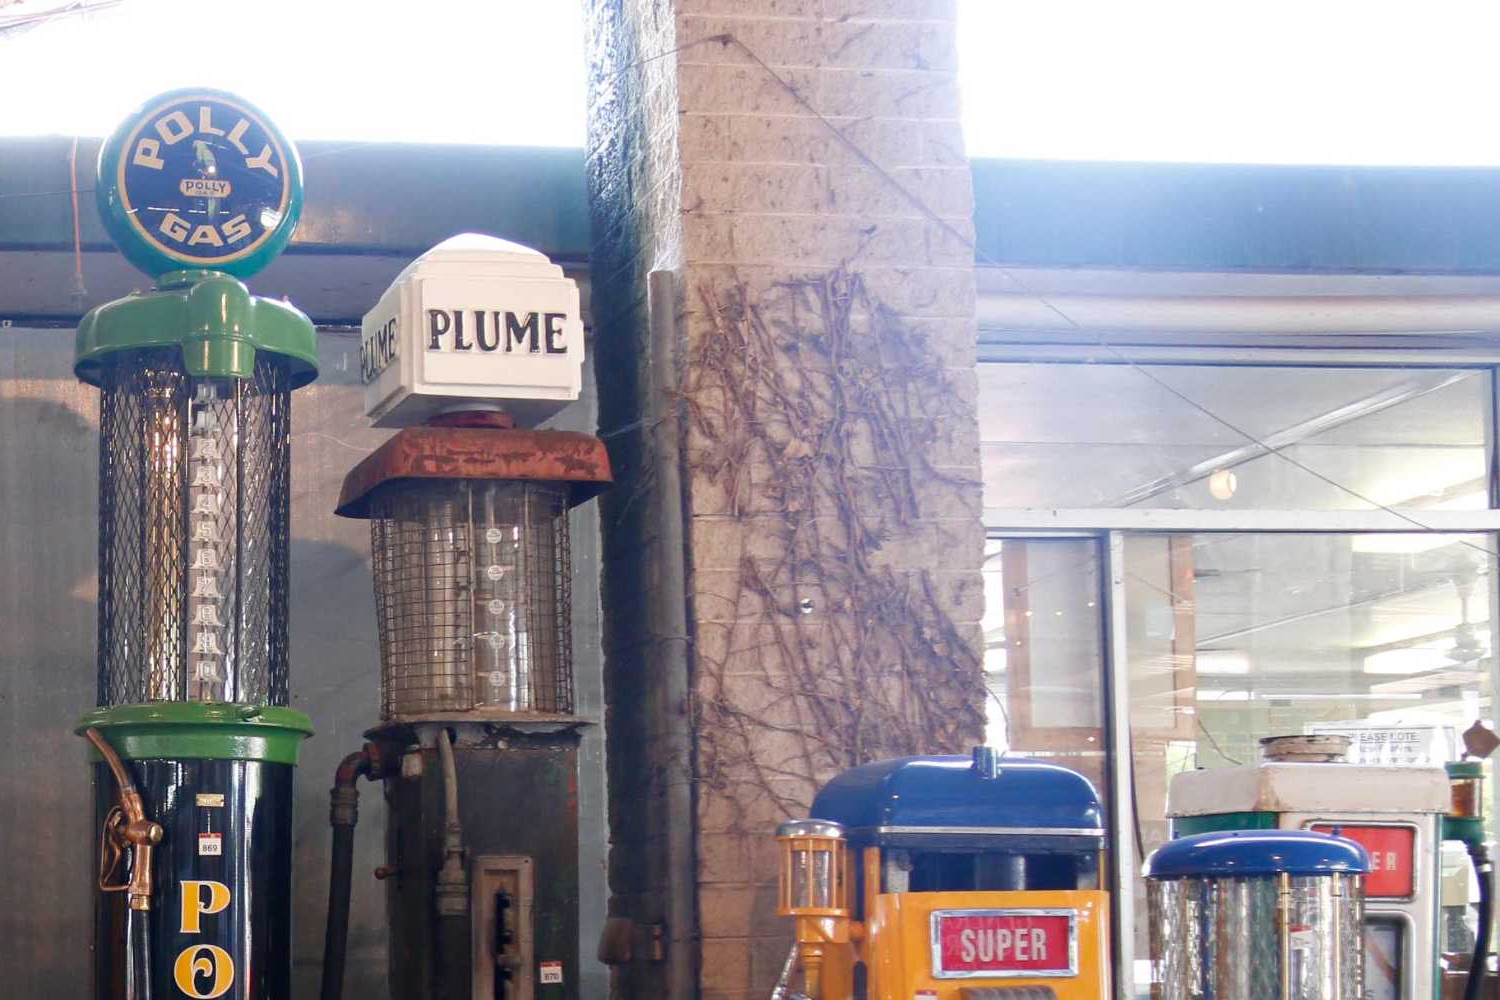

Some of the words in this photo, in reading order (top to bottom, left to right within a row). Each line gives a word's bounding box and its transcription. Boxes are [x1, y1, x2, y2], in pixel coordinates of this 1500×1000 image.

[132, 106, 278, 179] POLLY
[186, 181, 226, 193] POLLY
[160, 212, 252, 247] GAS
[427, 309, 568, 354] PLUME
[360, 317, 397, 385] PLUME
[202, 844, 218, 852] 869
[960, 928, 1047, 963] SUPER
